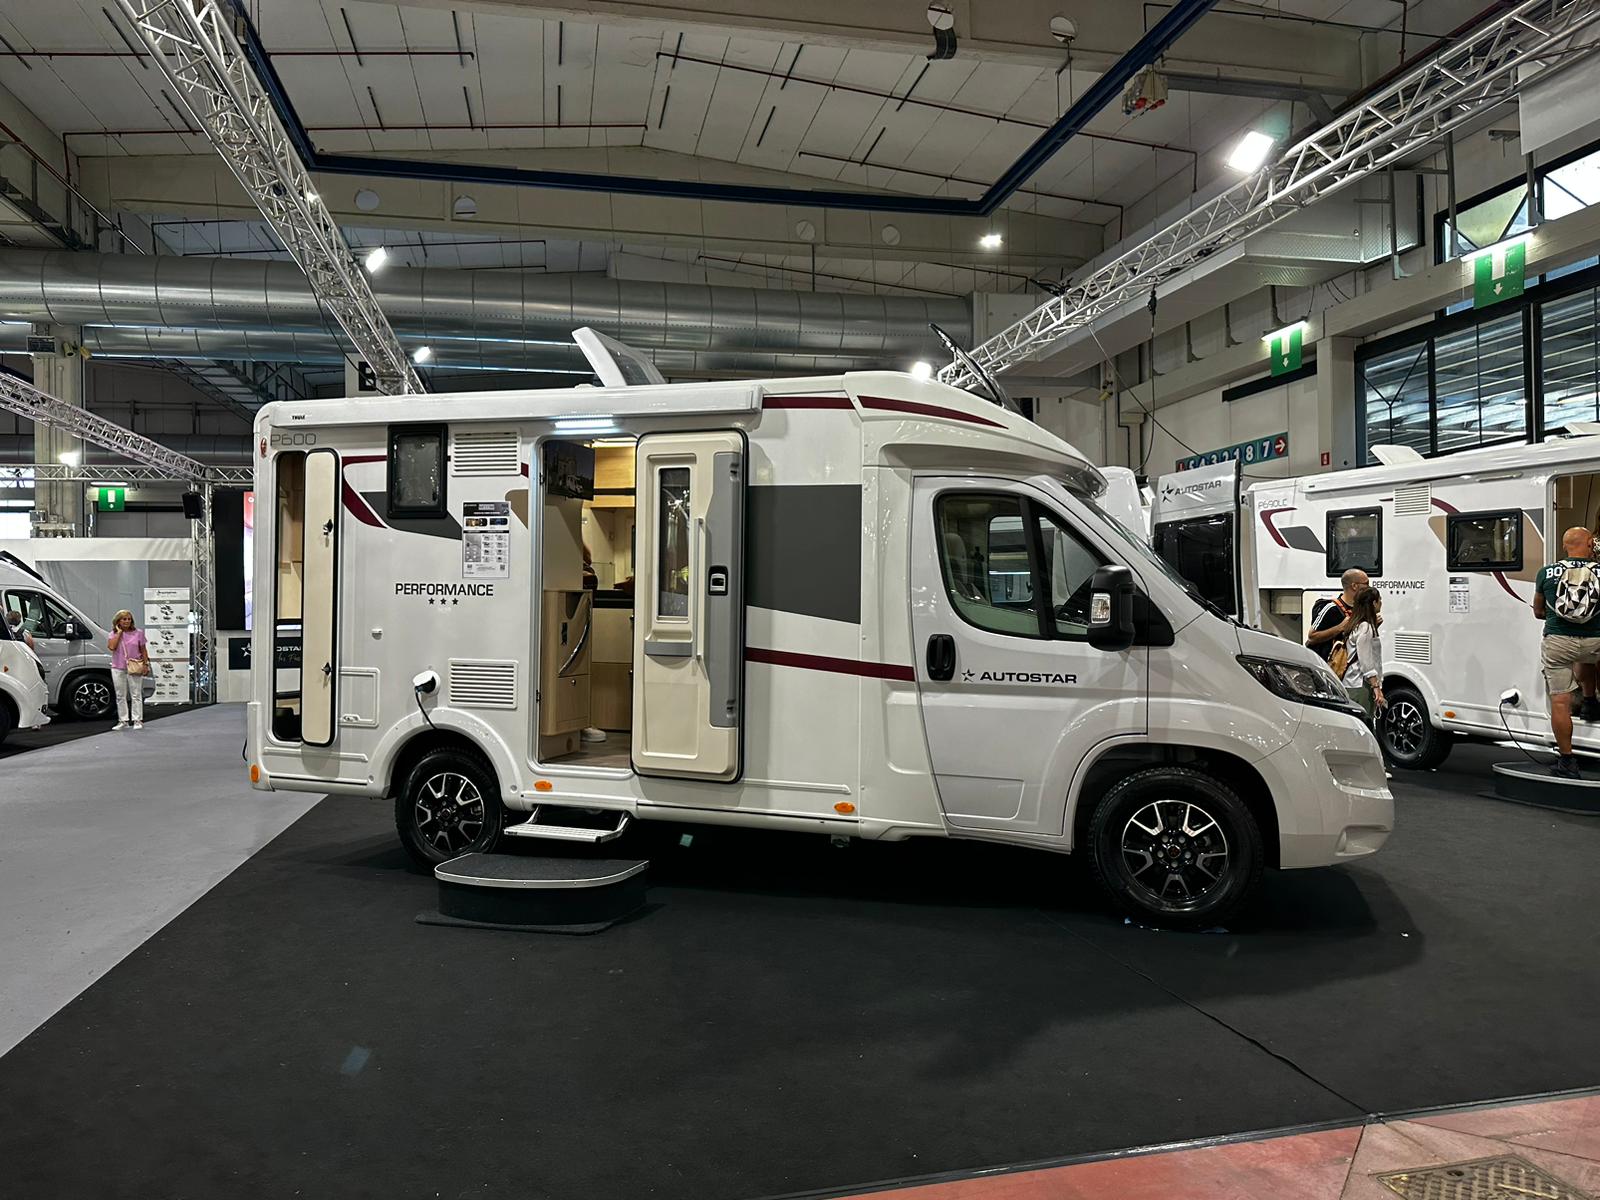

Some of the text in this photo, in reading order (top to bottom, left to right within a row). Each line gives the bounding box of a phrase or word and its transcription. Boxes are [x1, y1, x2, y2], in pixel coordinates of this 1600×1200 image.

[270, 433, 317, 447] P600
[1245, 445, 1254, 462] 8
[1262, 440, 1270, 458] 7
[1175, 480, 1222, 496] AUTOSTAR
[395, 582, 494, 597] PERFORMANCE
[1372, 580, 1425, 589] PERFORMANCE
[979, 671, 1078, 684] AUTOSTAR
